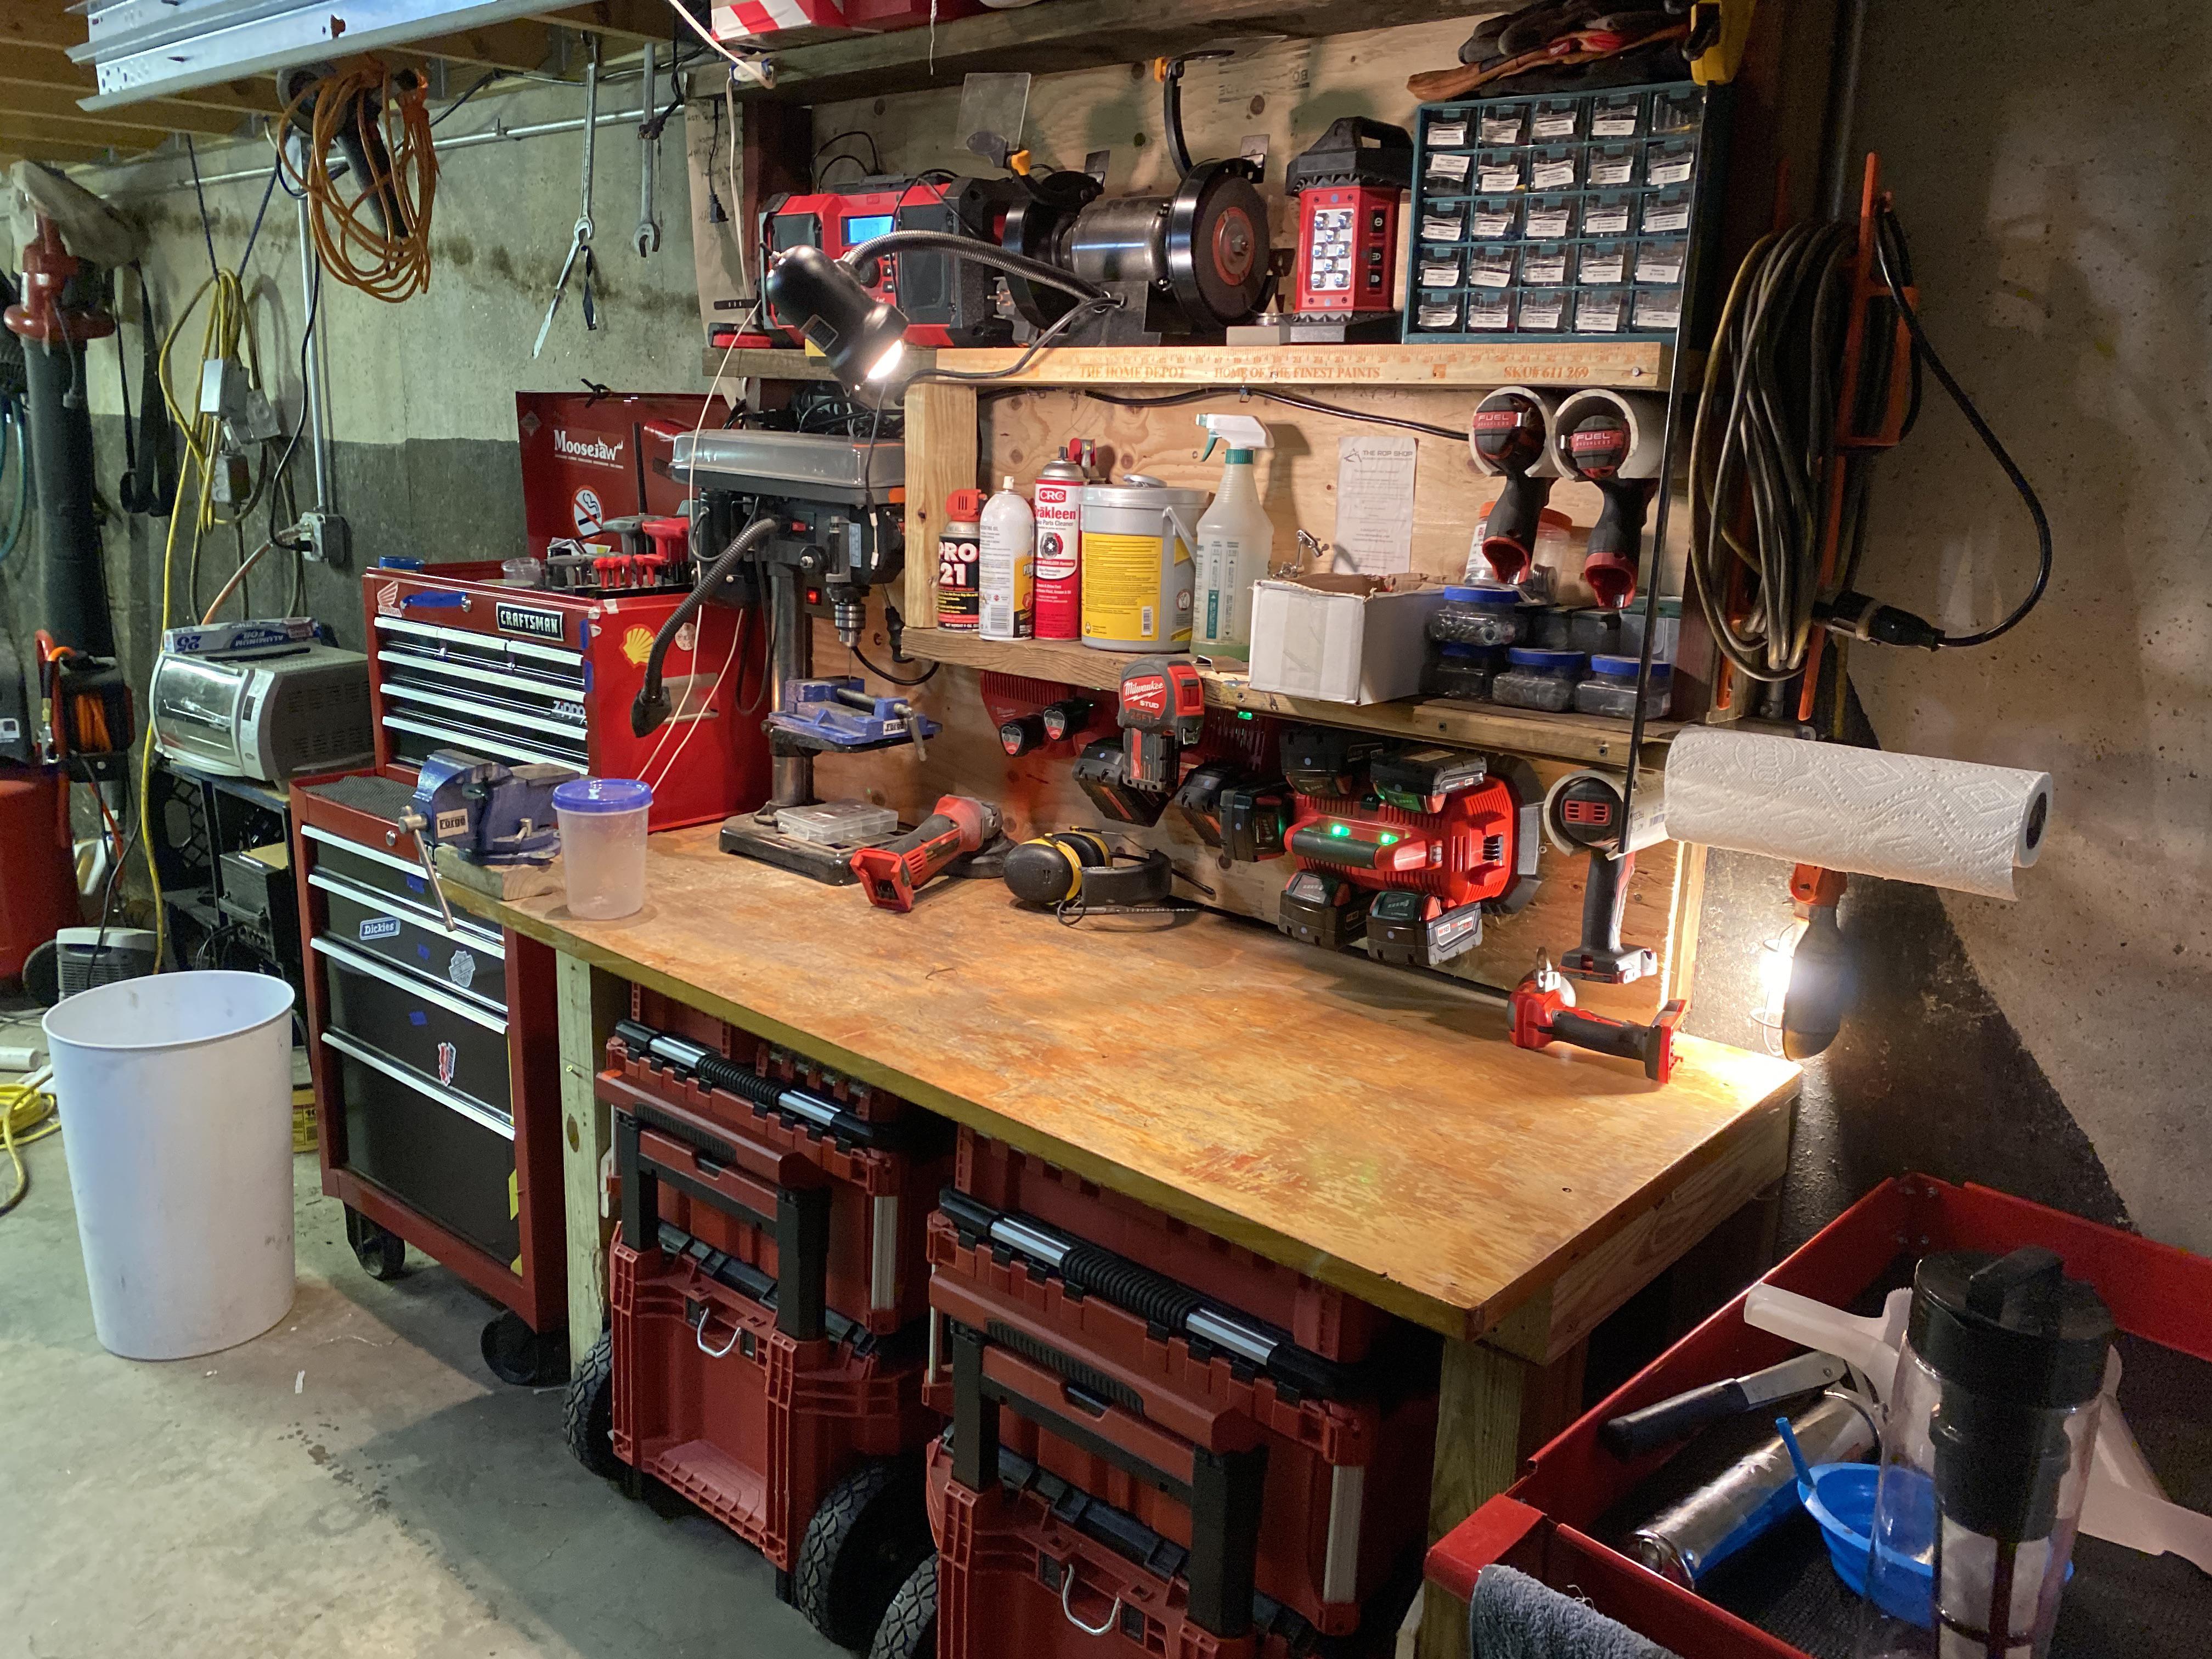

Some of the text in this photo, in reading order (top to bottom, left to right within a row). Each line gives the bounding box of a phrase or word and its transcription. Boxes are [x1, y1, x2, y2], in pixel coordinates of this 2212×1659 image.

[1079, 366, 1186, 378] THE HOME DEPOT
[1214, 367, 1381, 378] HOME OF THE FINEST PAINTS
[1504, 366, 1539, 378] SKU#
[1542, 367, 1562, 378] 611
[1576, 433, 1611, 441] FUEL
[554, 430, 623, 460] Moosejaw
[1040, 490, 1064, 500] CRC
[939, 541, 979, 562] PRO
[940, 562, 967, 585] 21
[500, 610, 558, 633] CRAFTSMAN
[235, 635, 284, 646] ALUMINUM
[242, 630, 266, 639] FOIL
[176, 635, 201, 652] 25
[1124, 680, 1164, 696] Milwaukee
[1139, 700, 1159, 709] STUD
[364, 922, 394, 935] Dickies
